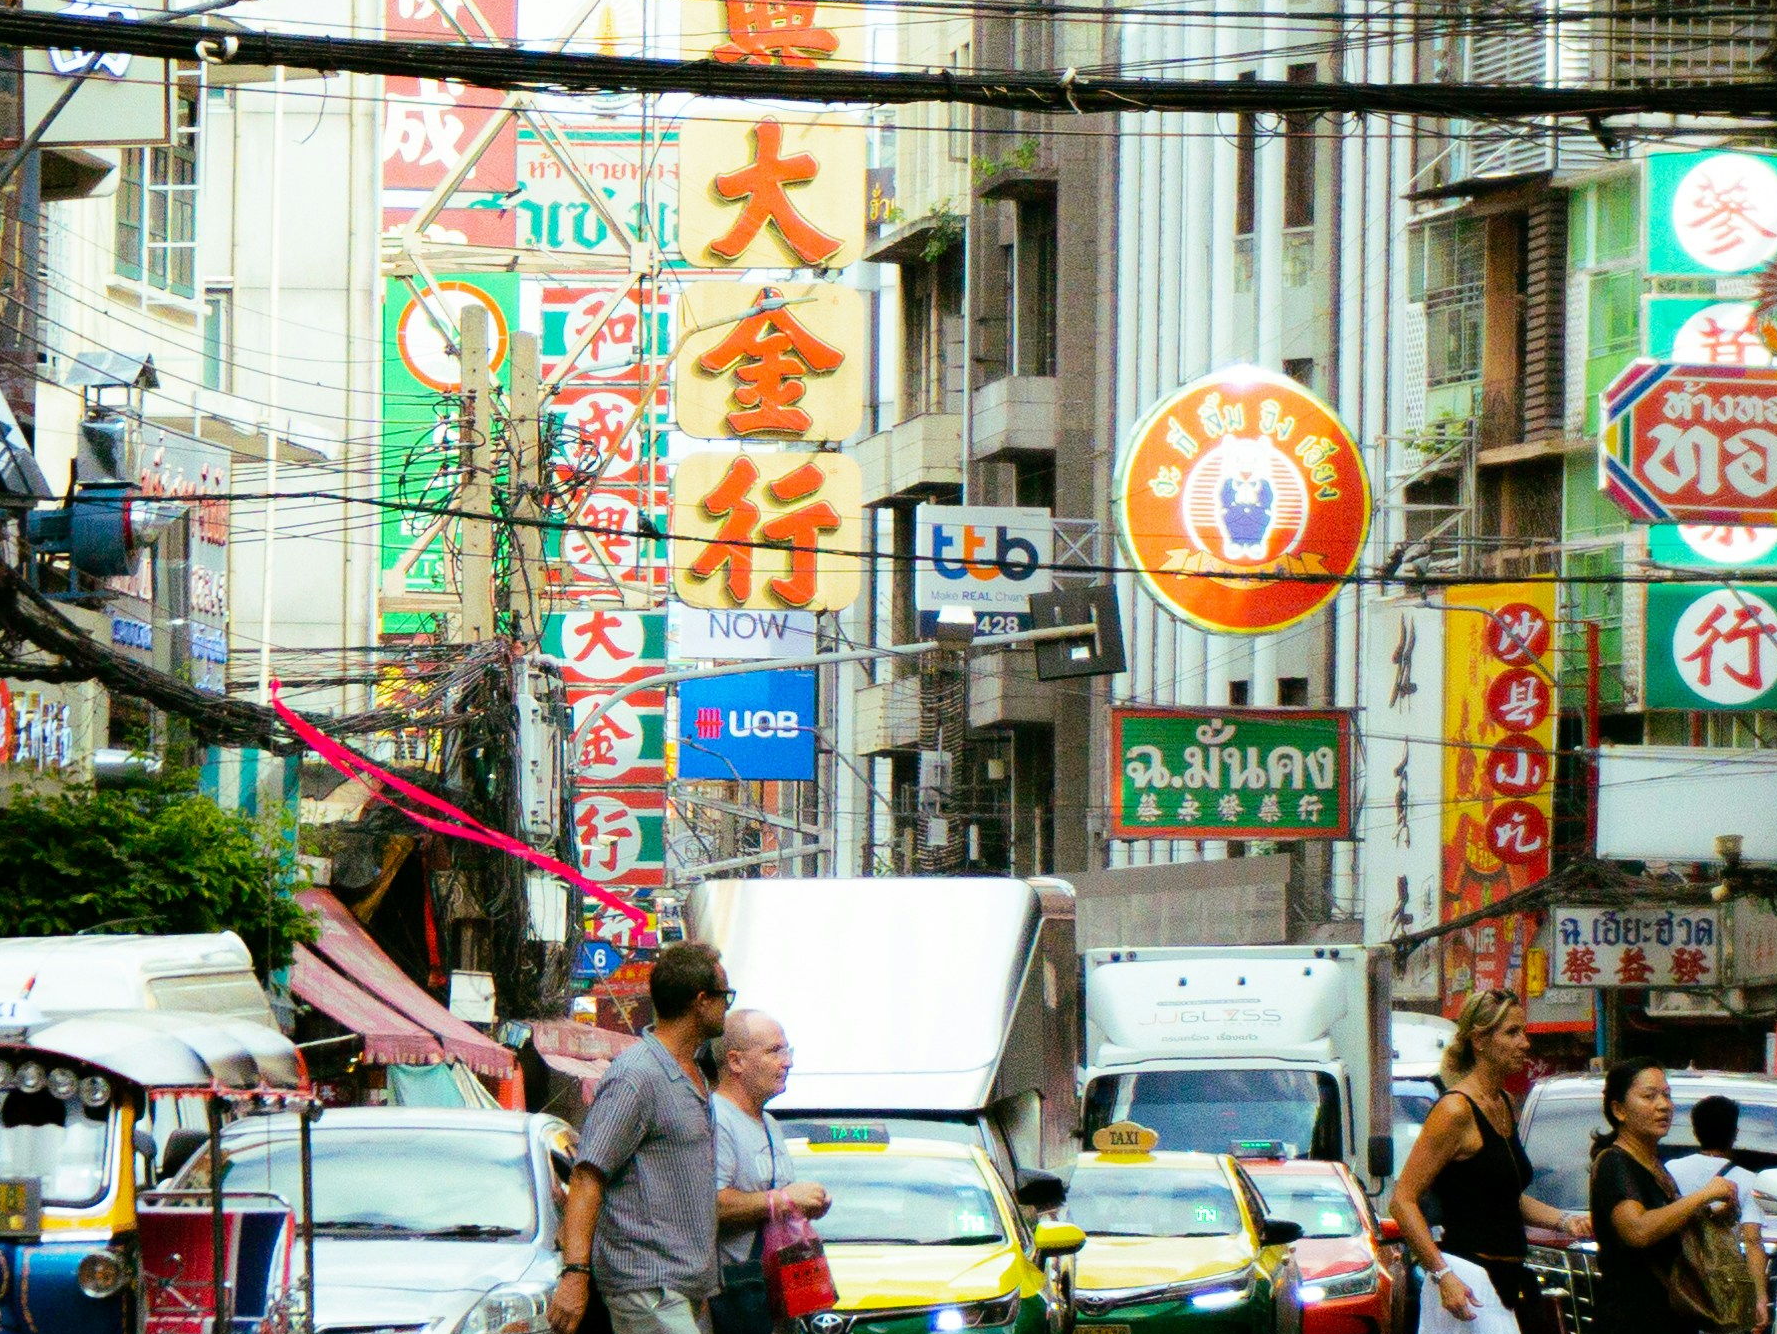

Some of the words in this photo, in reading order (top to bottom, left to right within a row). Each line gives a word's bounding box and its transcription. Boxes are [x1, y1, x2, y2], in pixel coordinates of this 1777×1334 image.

[932, 523, 1039, 581] ttb
[931, 590, 959, 602] Make
[962, 590, 993, 603] REAL
[995, 590, 1030, 605] Chan
[709, 613, 790, 641] NOW
[728, 710, 799, 738] UOB
[1495, 610, 1543, 854] 沙县小吃
[1125, 717, 1335, 789] ฉ.มั่นคง
[593, 948, 607, 968] 6
[829, 1125, 870, 1141] TAXI
[1108, 1130, 1140, 1146] TAXI
